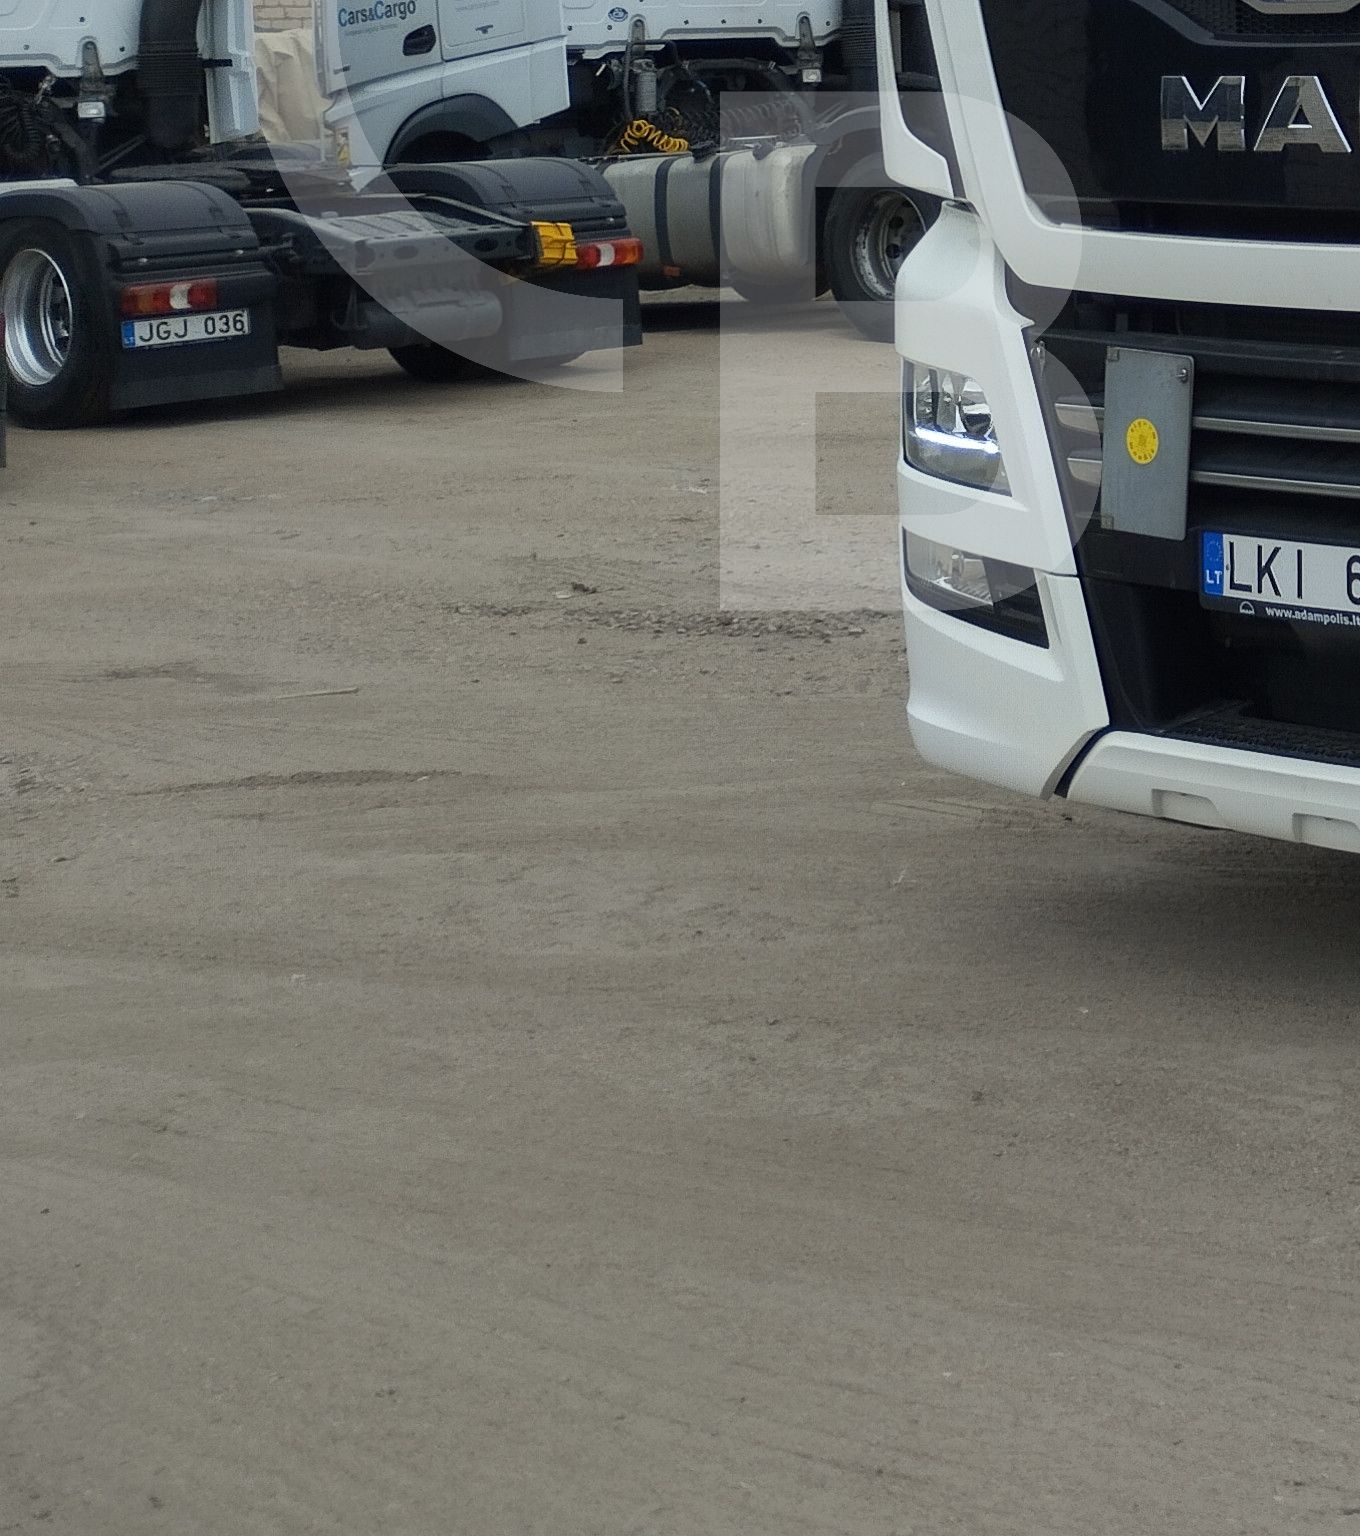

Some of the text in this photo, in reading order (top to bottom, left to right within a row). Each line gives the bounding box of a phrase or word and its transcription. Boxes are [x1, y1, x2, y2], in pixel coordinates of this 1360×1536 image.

[338, 0, 416, 28] Cars&Cargo
[139, 319, 188, 342] JGJ
[204, 313, 245, 335] 036
[1206, 570, 1223, 584] LT
[1229, 541, 1303, 599] LKI
